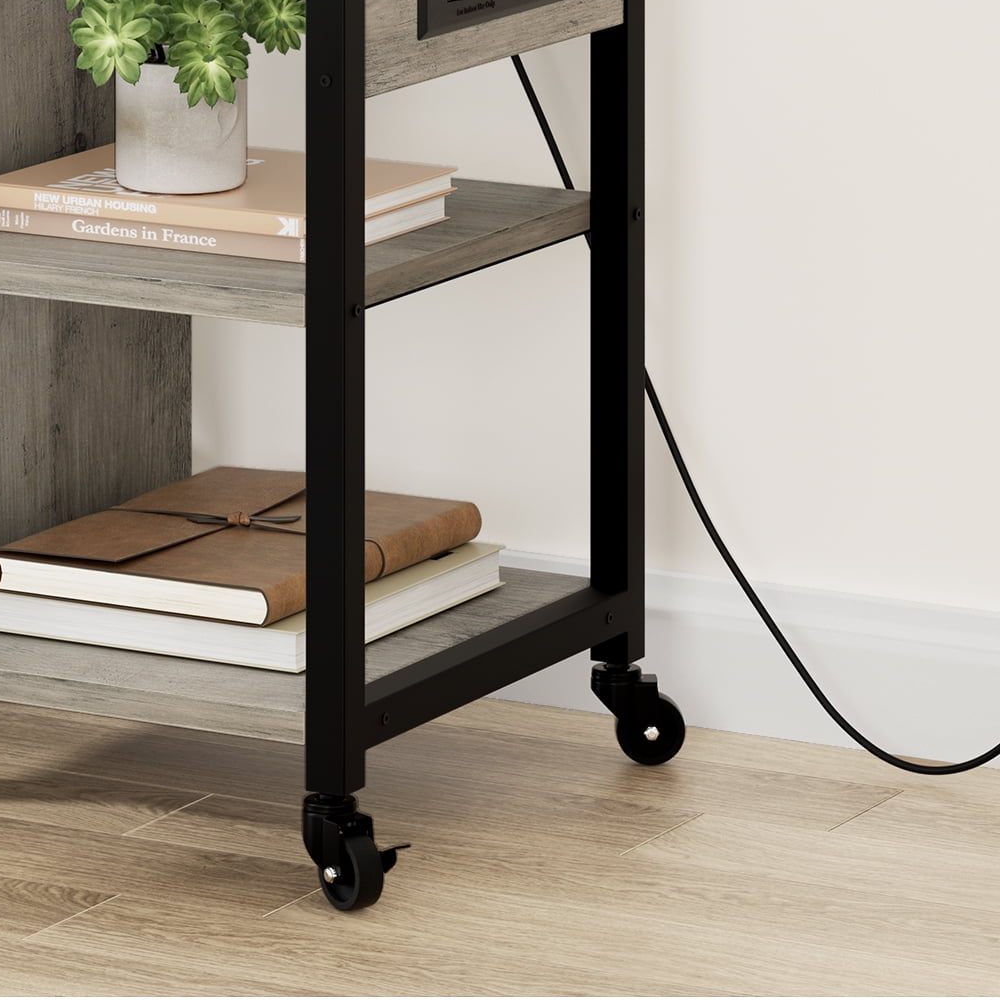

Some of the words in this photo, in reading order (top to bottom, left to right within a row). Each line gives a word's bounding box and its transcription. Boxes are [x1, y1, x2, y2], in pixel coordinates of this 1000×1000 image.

[34, 193, 59, 203] NEW
[62, 196, 101, 208] URBAN
[104, 200, 156, 214] HOUSING
[34, 202, 63, 211] HILARY
[65, 206, 99, 216] FRENCH
[72, 219, 138, 239] Gardens
[142, 226, 157, 241] in
[161, 228, 217, 247] France
